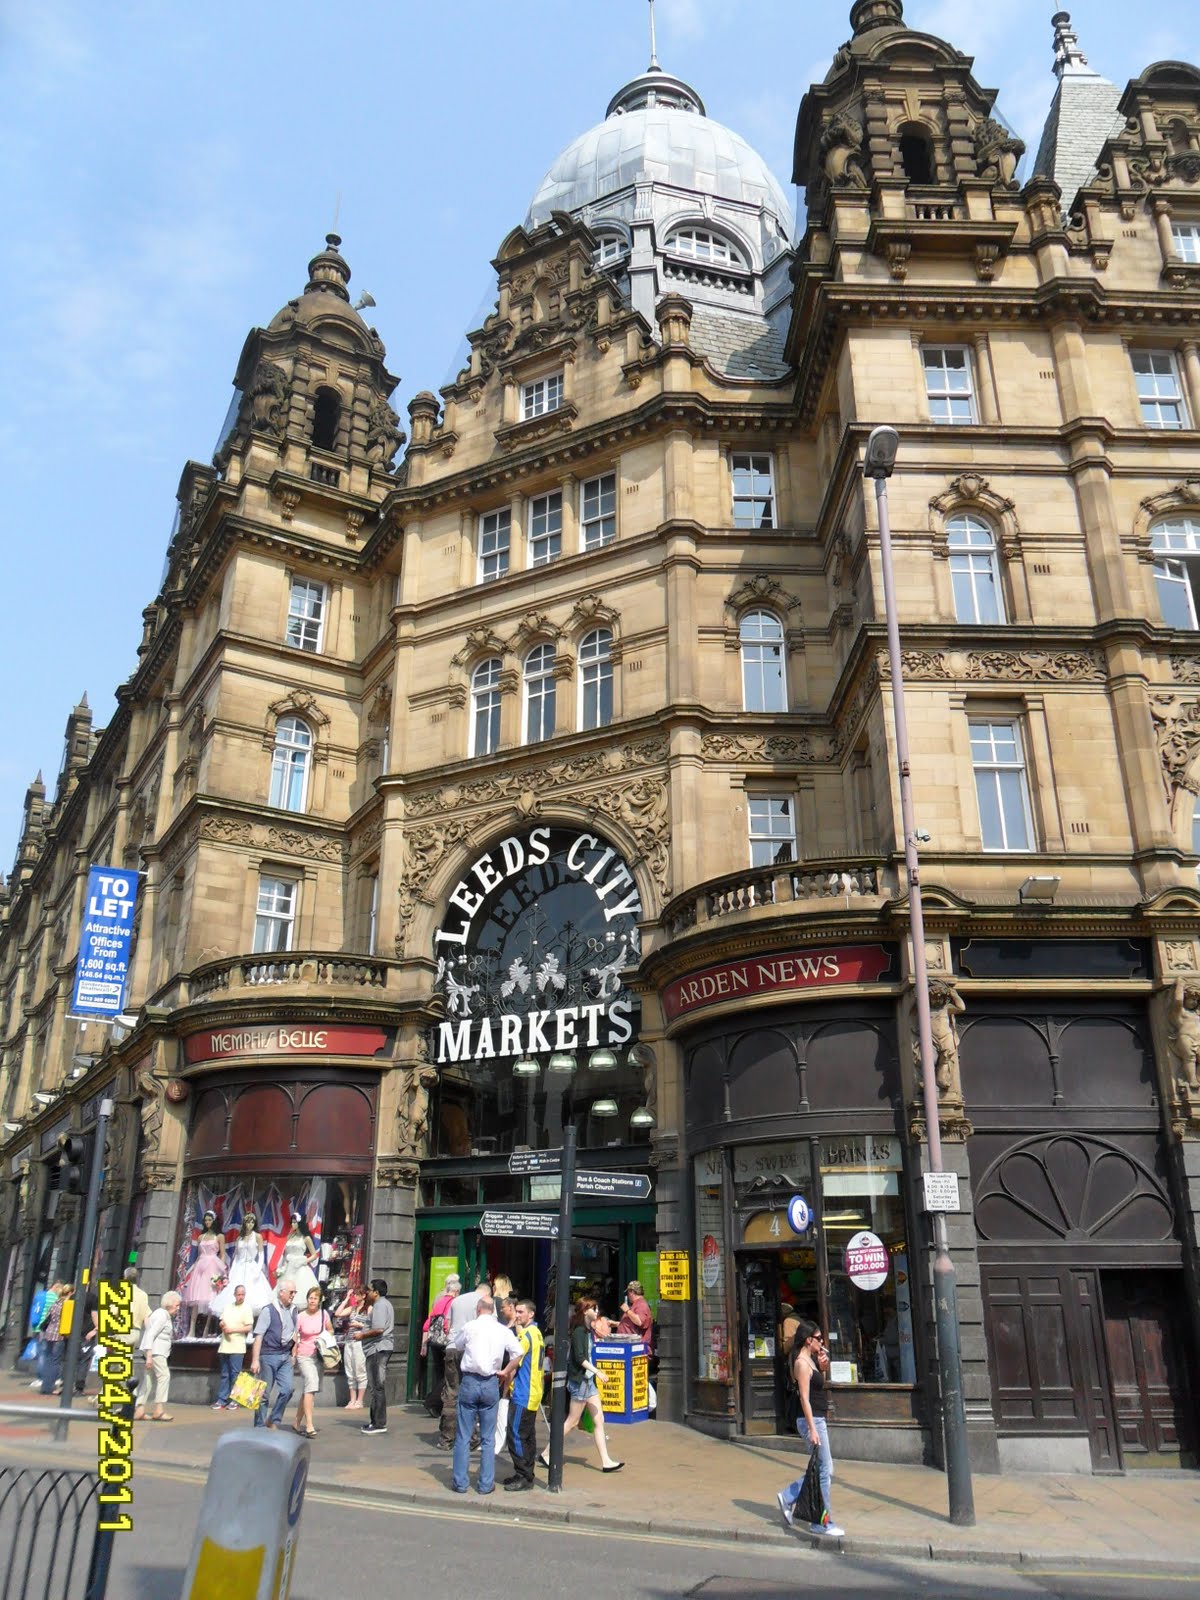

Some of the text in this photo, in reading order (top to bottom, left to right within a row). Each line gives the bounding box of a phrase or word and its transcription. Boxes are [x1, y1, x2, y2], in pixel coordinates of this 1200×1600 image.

[98, 876, 129, 898] TO
[435, 827, 642, 946] LEEDS CITY
[88, 897, 134, 919] LET
[85, 922, 130, 937] Attractive
[89, 936, 123, 949] Offices
[93, 947, 117, 958] From
[80, 958, 127, 973] 1,600 sq.ft.
[679, 954, 840, 1007] ARDEN NEWS
[437, 1000, 633, 1063] MARKETS
[211, 1028, 328, 1053] MEMPHIS BELLE
[593, 1176, 611, 1184] Coach
[594, 1183, 615, 1191] Church
[769, 1215, 781, 1237] 4
[848, 1252, 884, 1264] TO WIN
[849, 1262, 885, 1272] £500,000
